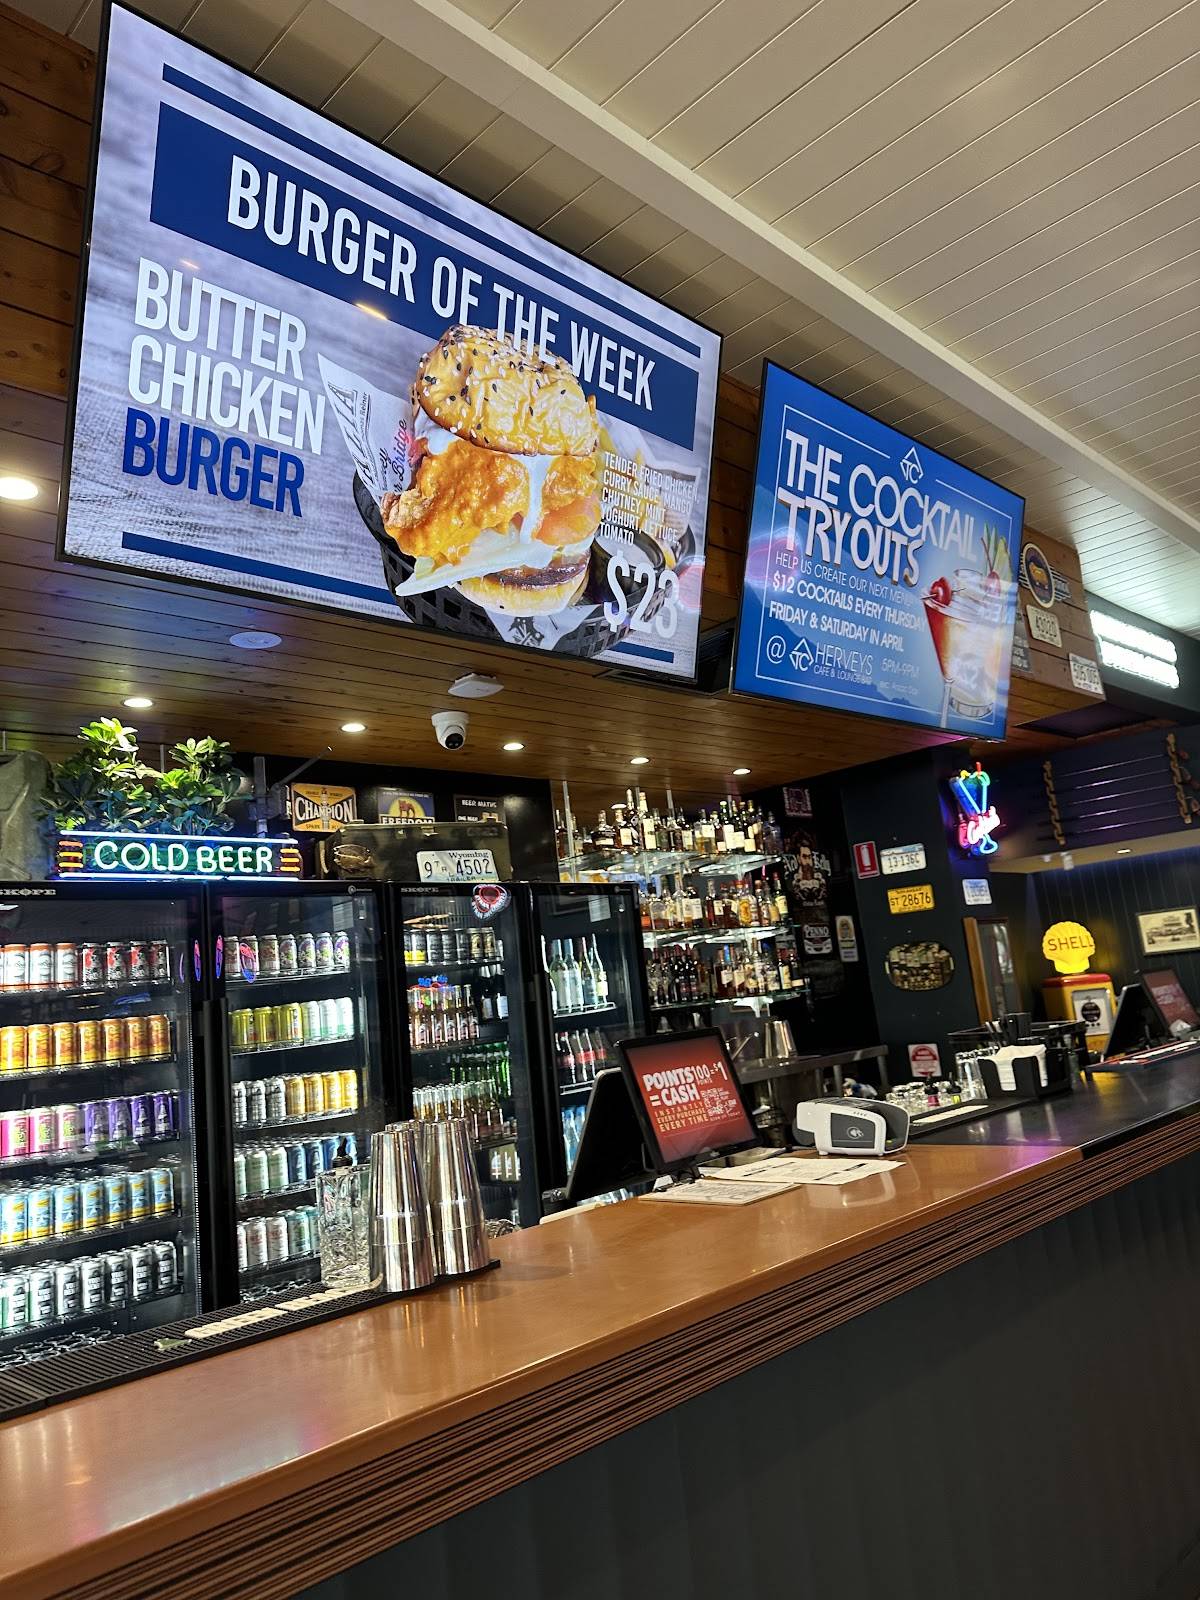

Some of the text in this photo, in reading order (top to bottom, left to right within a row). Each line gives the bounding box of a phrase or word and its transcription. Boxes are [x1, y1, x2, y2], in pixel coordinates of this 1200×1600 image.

[227, 155, 656, 411] BURGER OF THE WEEK
[135, 257, 307, 380] BUTTER
[128, 335, 325, 455] CHICKEN
[122, 407, 304, 517] BURGER
[391, 418, 410, 480] Bridge
[604, 452, 638, 477] TENDER
[640, 465, 662, 488] FRIED
[603, 470, 632, 494] CURRY
[664, 493, 691, 514] MANGO
[785, 428, 977, 562] THE COCKTAIL
[645, 502, 666, 522] MINT
[600, 521, 635, 546] TOMATO
[775, 551, 798, 569] HELP
[800, 559, 812, 576] US
[814, 564, 847, 586] CREATE
[848, 575, 868, 592] OUR
[869, 582, 889, 599] NEXT
[604, 551, 680, 638] $23
[772, 570, 927, 632] $12 COCKTAILS EVERY THURSDAY
[769, 601, 904, 652] FRIDAY & SATURDAY IN APRIL
[766, 635, 787, 664] @
[815, 641, 874, 675] HERVEYS
[813, 664, 829, 677] CAFE
[295, 796, 354, 823] CHAMPION
[461, 799, 477, 808] BEER
[95, 840, 273, 873] COLD BEER
[424, 861, 433, 879] 9
[456, 858, 493, 876] 4502
[448, 850, 490, 860] Wyoming
[0, 888, 57, 896] KOPE
[901, 891, 932, 907] 28676
[1047, 935, 1095, 952] SHELL
[643, 1066, 694, 1092] POINTS
[661, 1083, 700, 1107] CASH
[655, 1101, 704, 1118] INSTANTLY
[657, 1114, 676, 1124] EVERY
[659, 1113, 709, 1133] EVERY TIME
